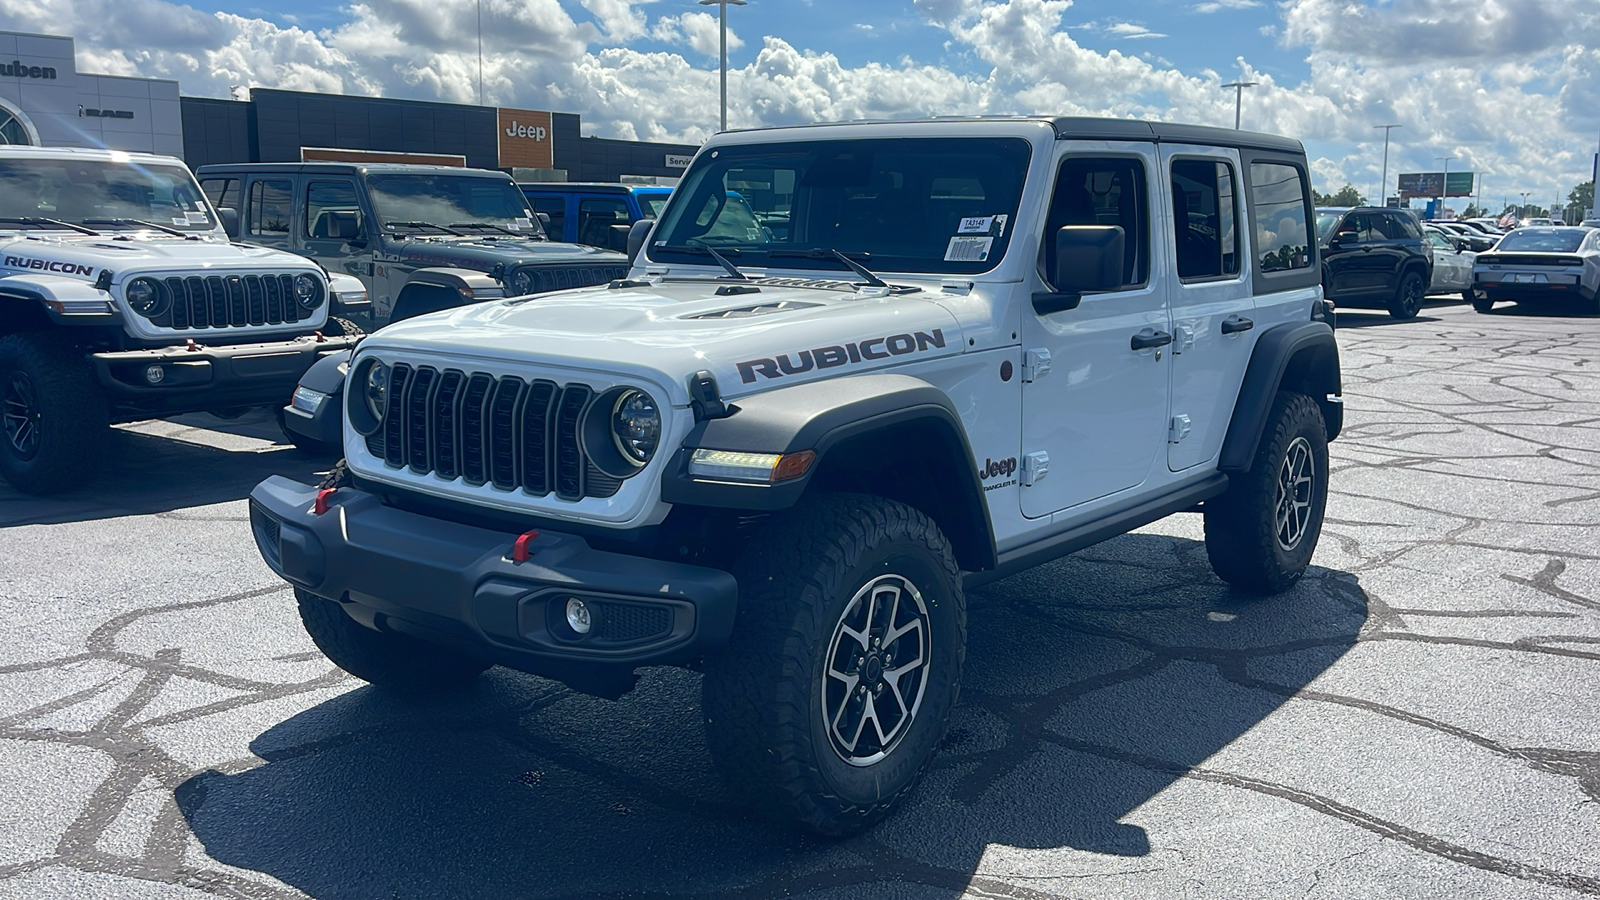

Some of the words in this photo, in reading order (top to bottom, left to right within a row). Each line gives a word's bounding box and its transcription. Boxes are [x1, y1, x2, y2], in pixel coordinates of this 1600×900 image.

[505, 120, 546, 142] Jeep
[4, 255, 94, 276] RUBICON
[408, 253, 488, 269] RUBICON
[735, 328, 946, 385] RUBICON
[980, 456, 1017, 480] Jeep
[983, 481, 1011, 493] RANGLER
